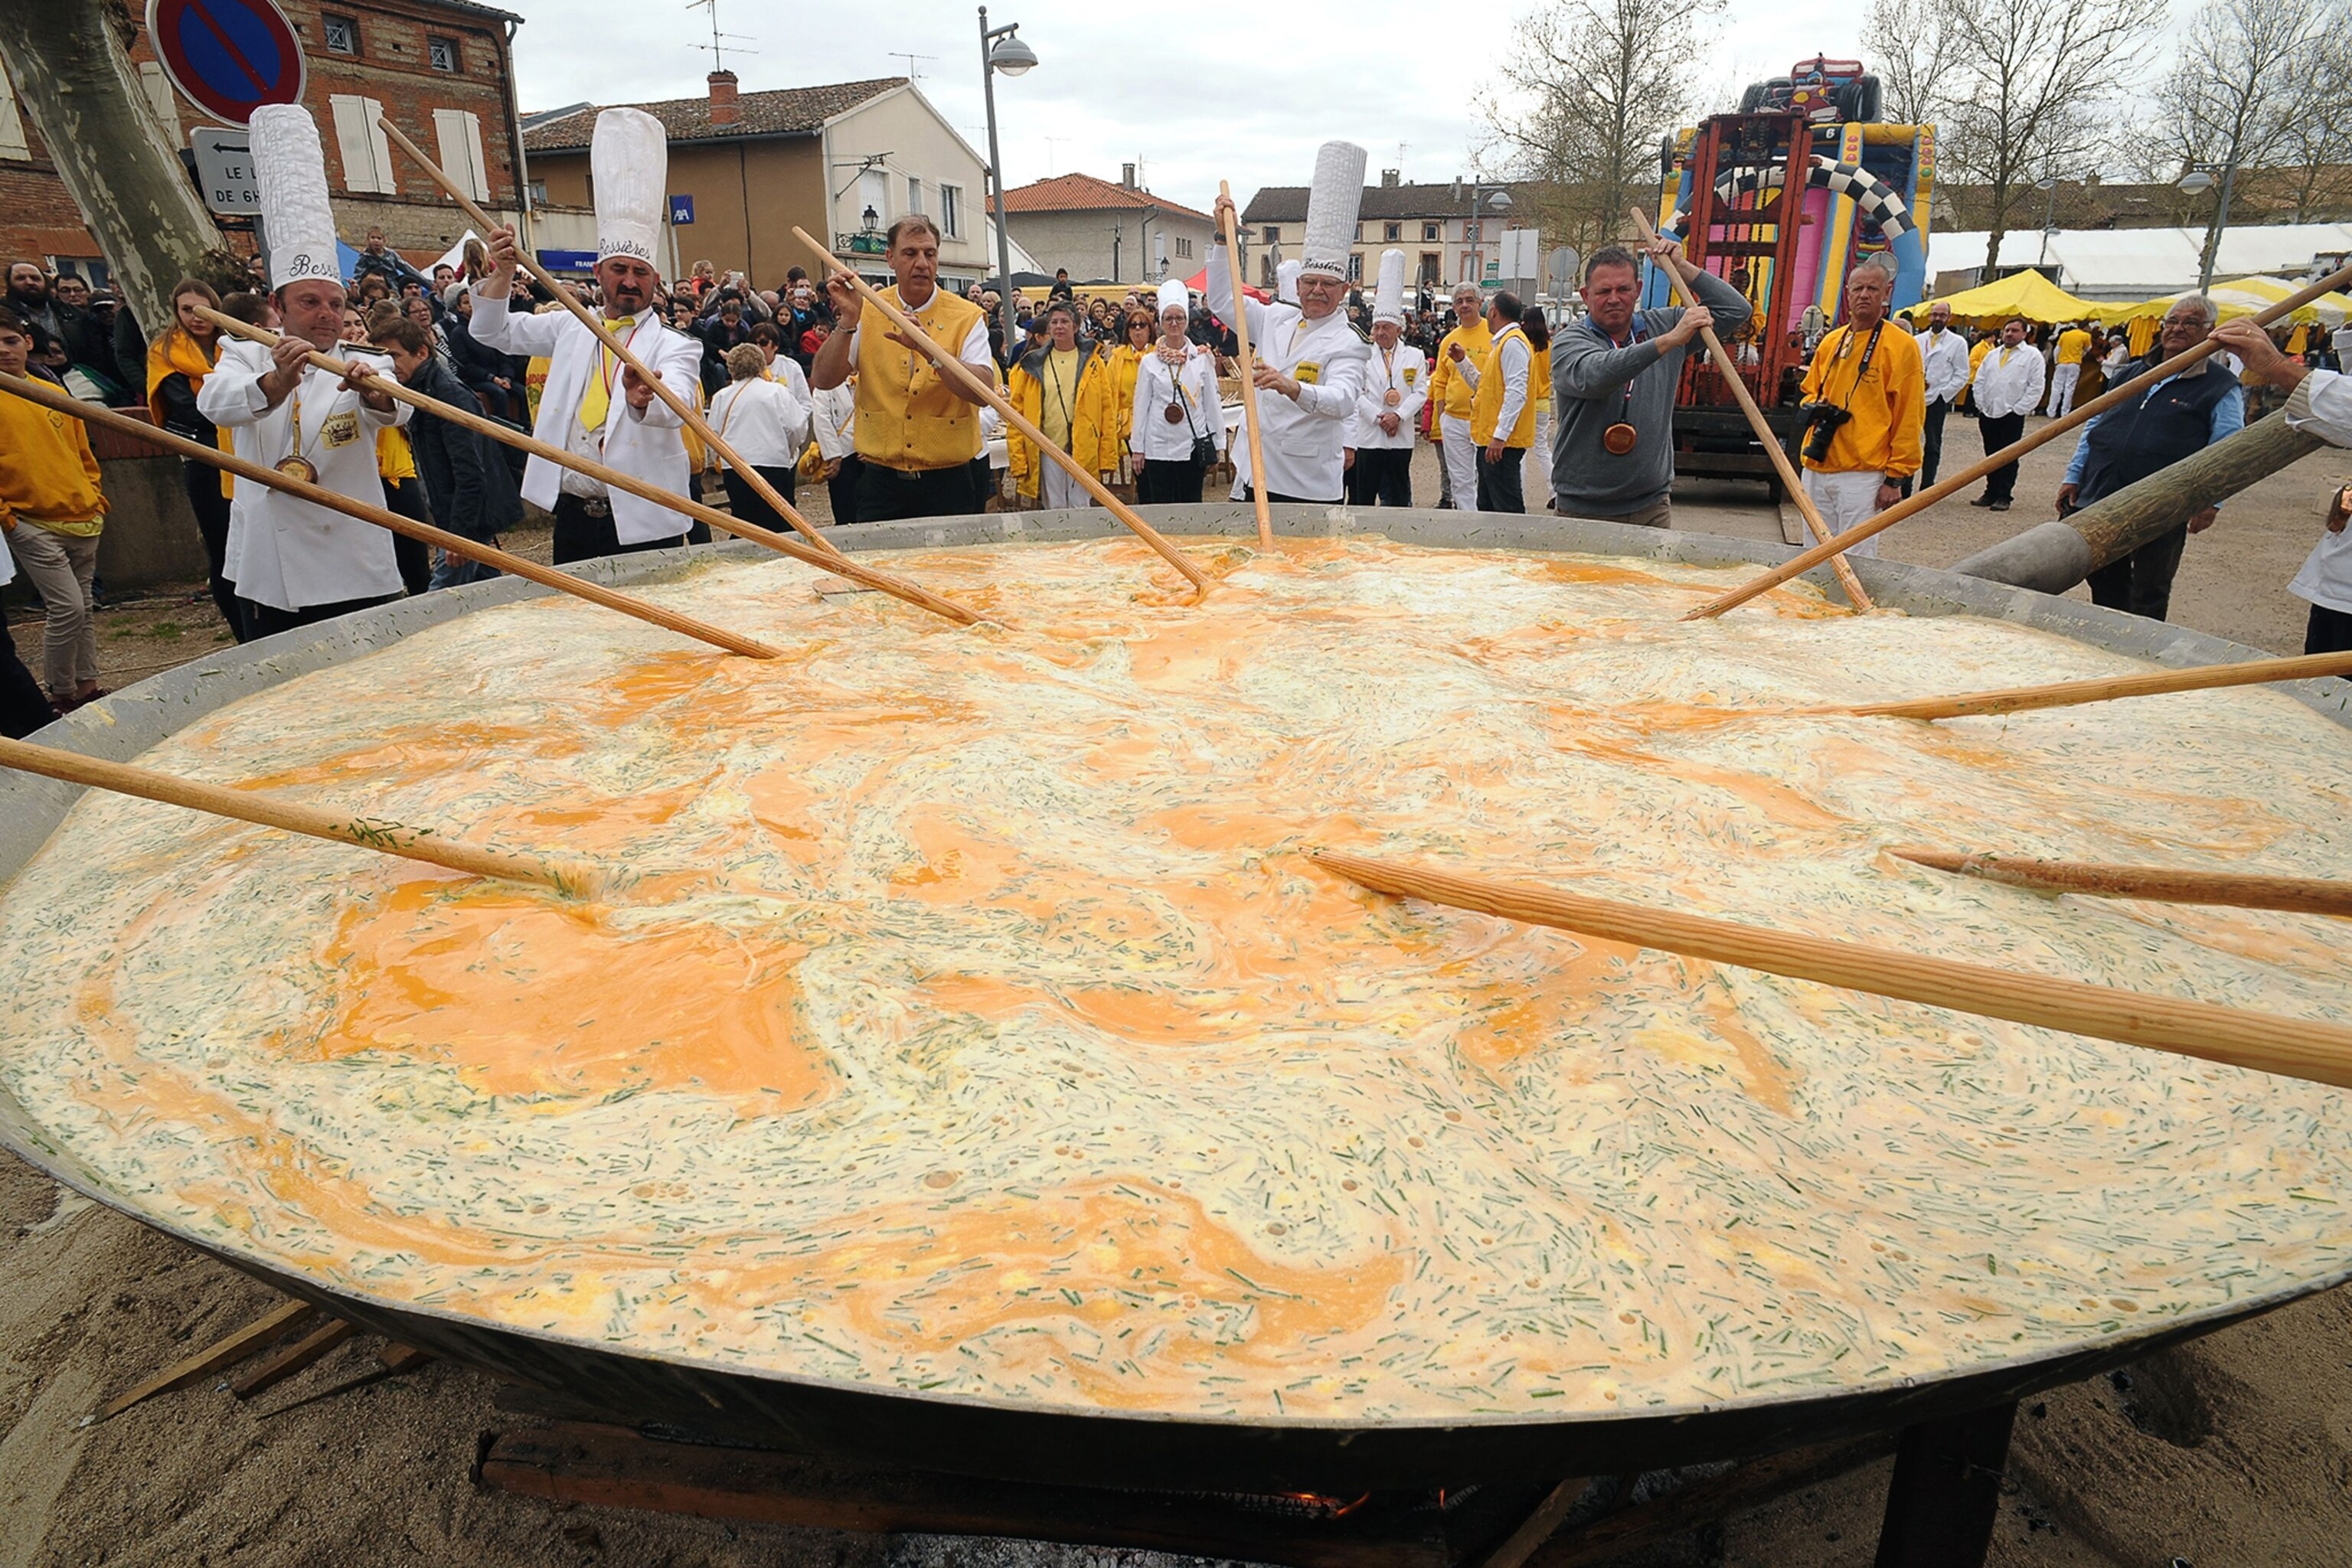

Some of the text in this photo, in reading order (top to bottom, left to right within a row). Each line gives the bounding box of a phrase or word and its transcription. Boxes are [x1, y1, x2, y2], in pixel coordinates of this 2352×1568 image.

[1825, 128, 1835, 139] 6
[225, 167, 242, 179] LE
[215, 190, 234, 203] DE
